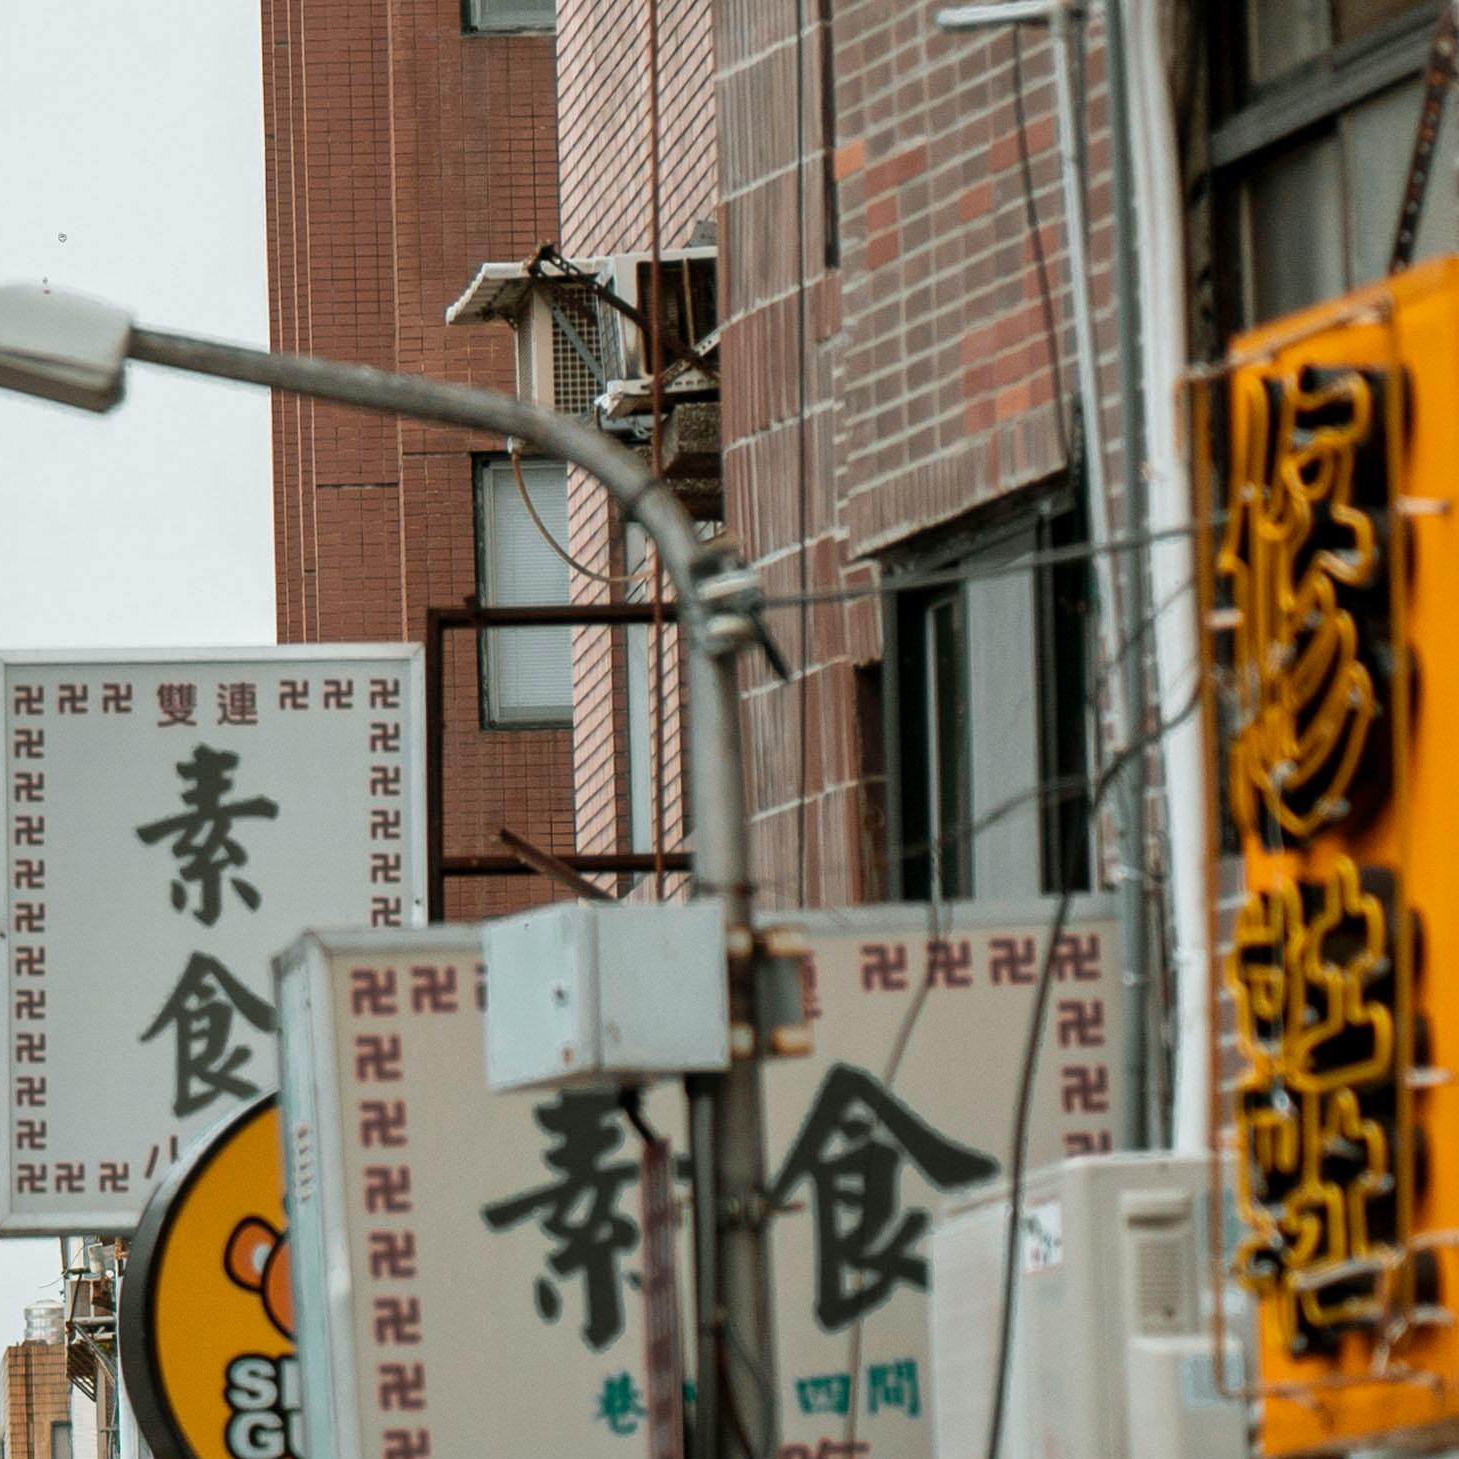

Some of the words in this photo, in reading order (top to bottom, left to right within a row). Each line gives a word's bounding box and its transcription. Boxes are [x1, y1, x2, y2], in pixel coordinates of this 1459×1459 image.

[156, 681, 258, 727] 雙連
[135, 742, 280, 1120] 素食
[485, 1060, 1003, 1352] 素食
